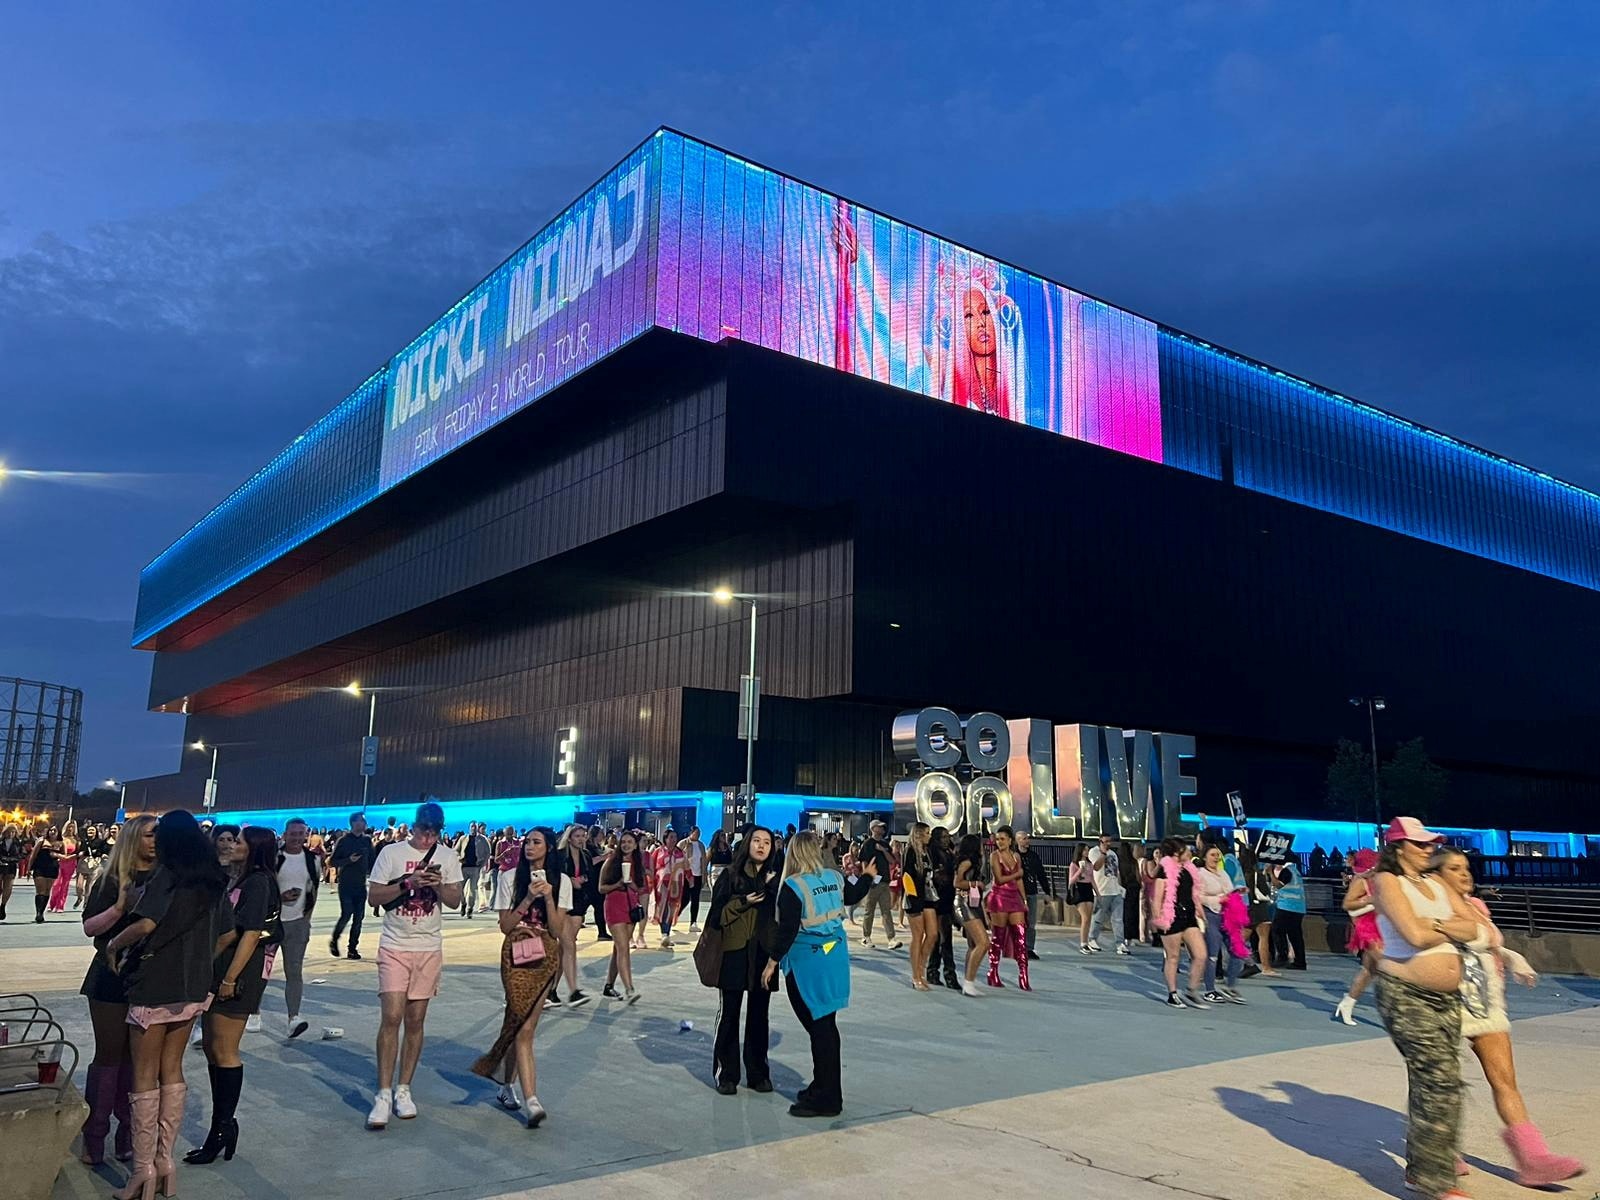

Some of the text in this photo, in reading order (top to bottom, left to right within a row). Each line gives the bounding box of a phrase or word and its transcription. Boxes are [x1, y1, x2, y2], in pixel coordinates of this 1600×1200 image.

[392, 161, 646, 430] NICKI MINAJ
[413, 322, 591, 460] PINK FRIDAY 2 WORLD TOUR
[1006, 717, 1198, 840] LIVE
[812, 884, 839, 896] STEWARD
[1266, 836, 1290, 849] TRAM
